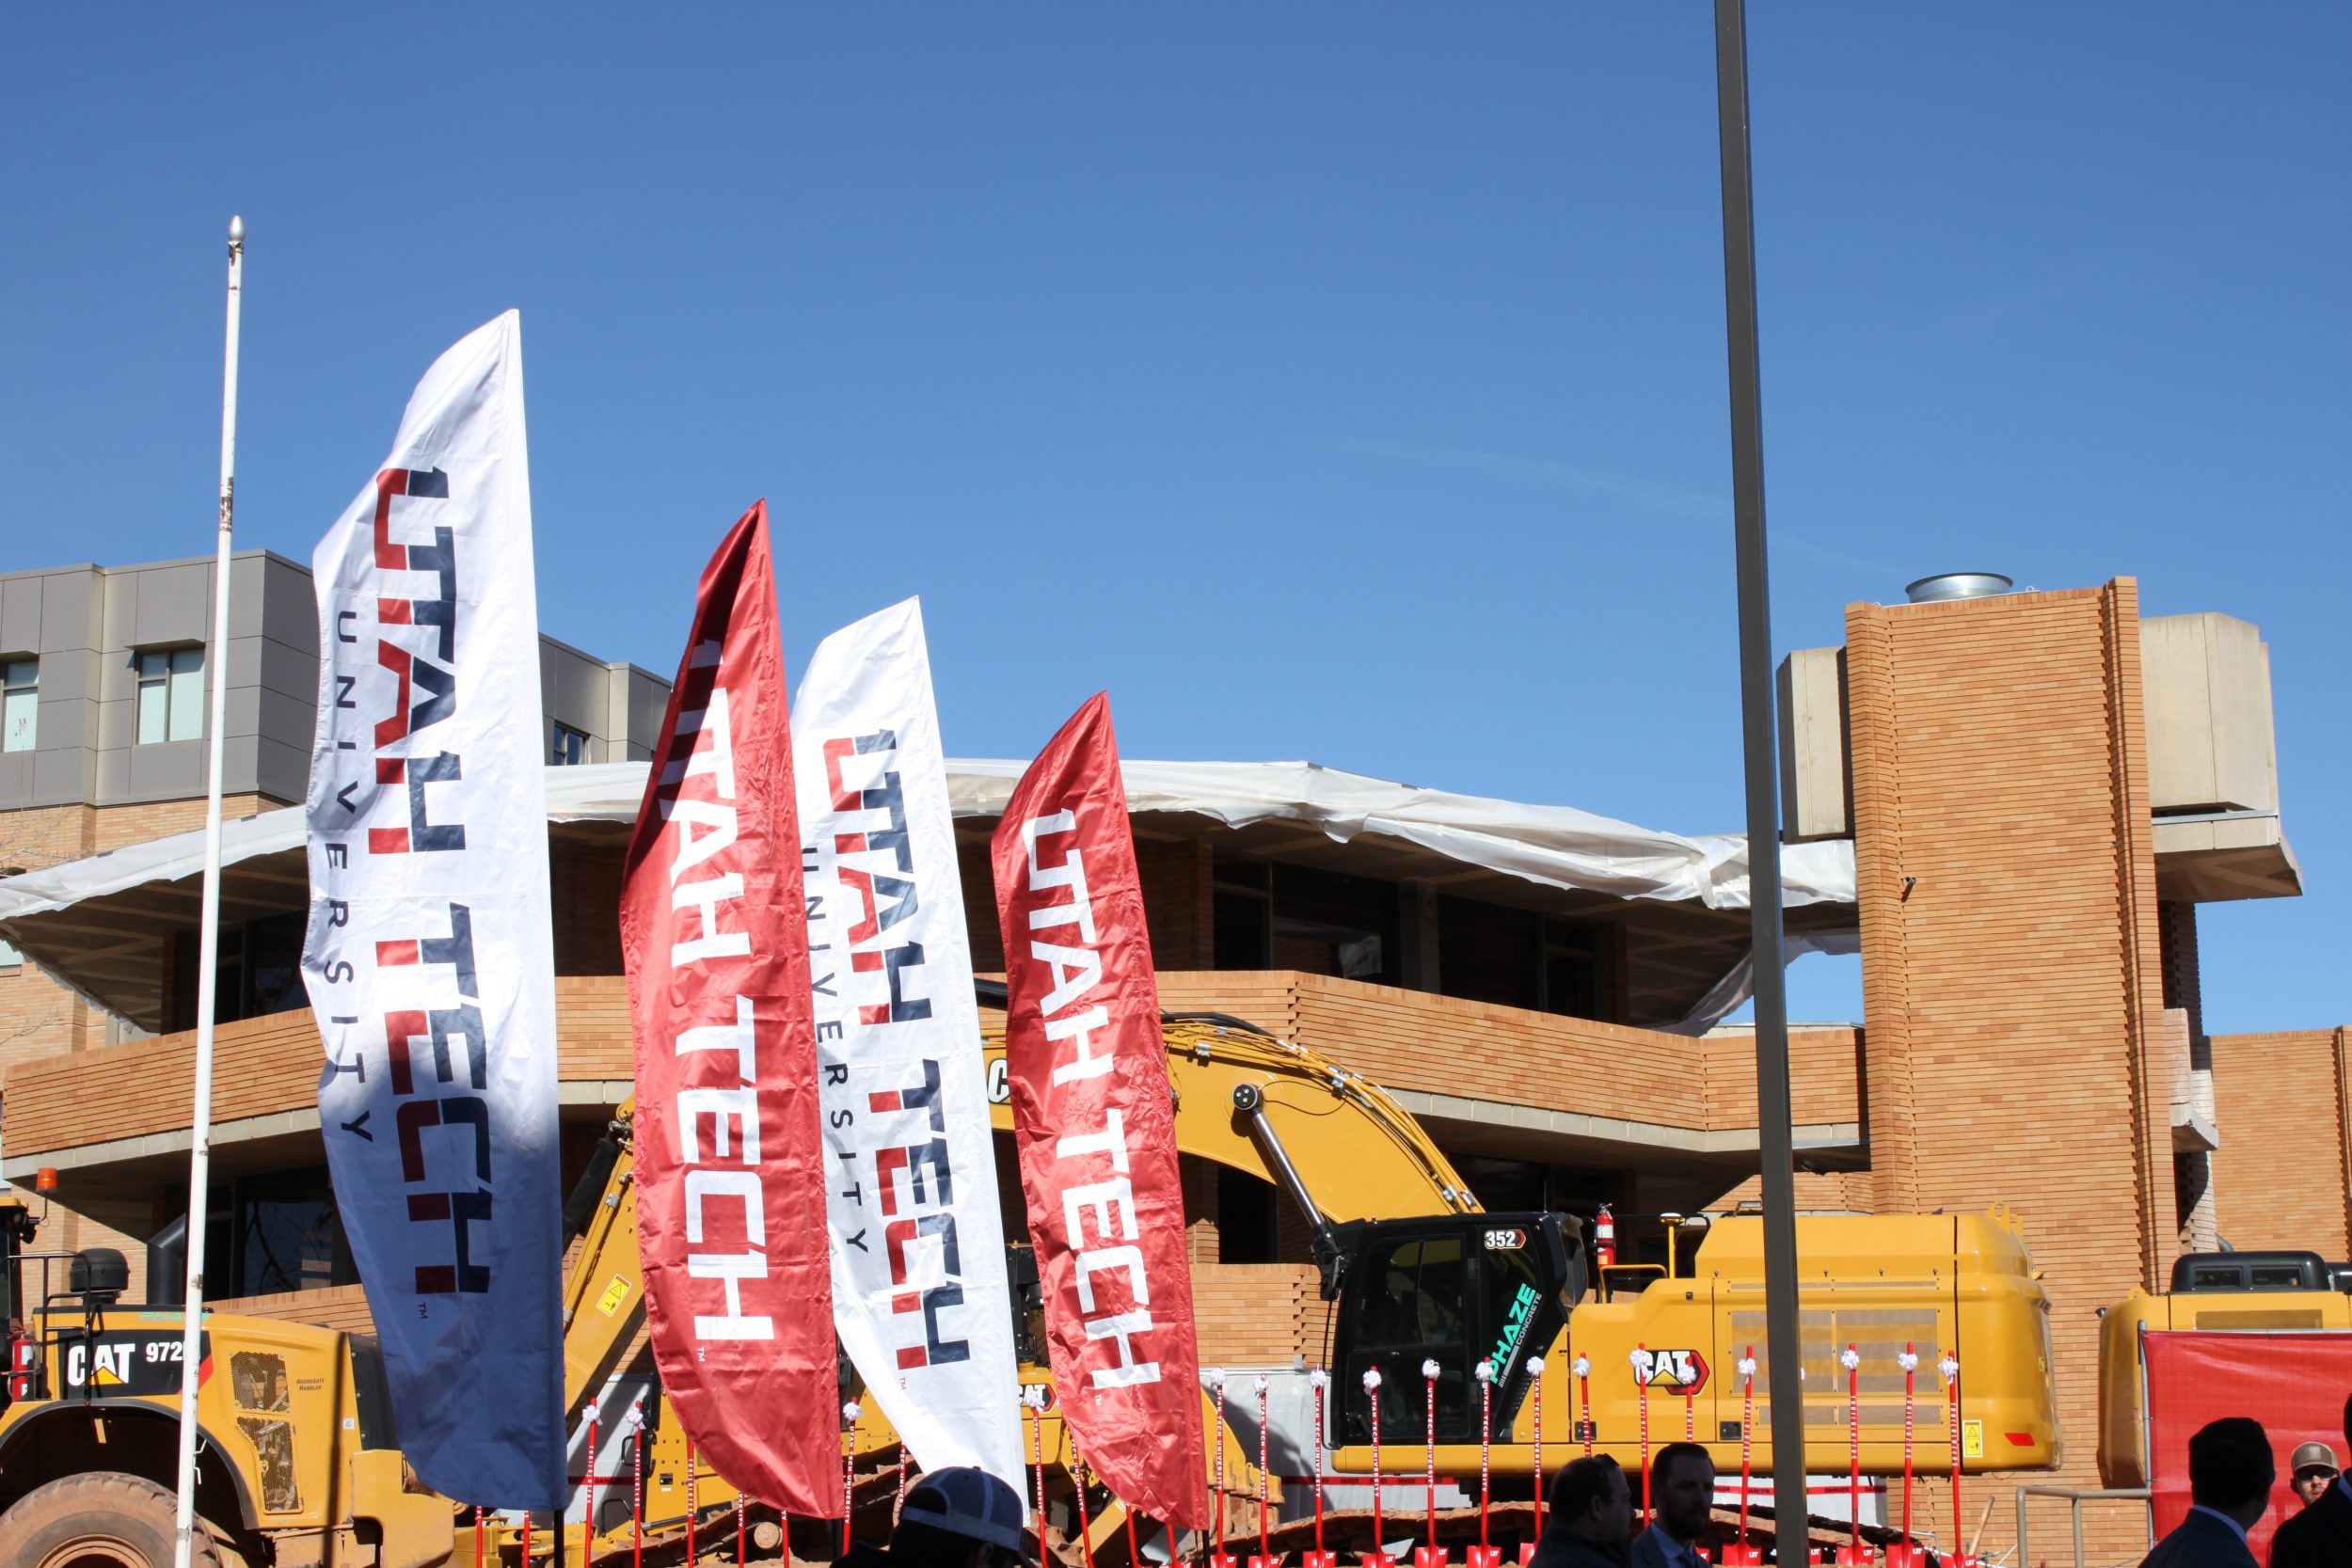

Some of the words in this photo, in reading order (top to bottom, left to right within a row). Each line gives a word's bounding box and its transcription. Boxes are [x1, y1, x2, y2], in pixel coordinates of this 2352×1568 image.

[369, 466, 466, 855] UTAH
[324, 610, 373, 1142] UNIVERSITY
[823, 729, 932, 1025] UTAH
[1021, 808, 1114, 1087] UTAH
[375, 901, 493, 1294] TECH
[675, 994, 774, 1340] TECH
[868, 1058, 970, 1370] TECH
[68, 1343, 135, 1386] CAT
[146, 1341, 185, 1362] 972
[1057, 1108, 1161, 1389] TECH
[1485, 1229, 1517, 1249] 352
[1489, 1283, 1536, 1384] PHAZE
[1516, 1292, 1542, 1346] CONCRETE
[1635, 1350, 1691, 1385] CAT
